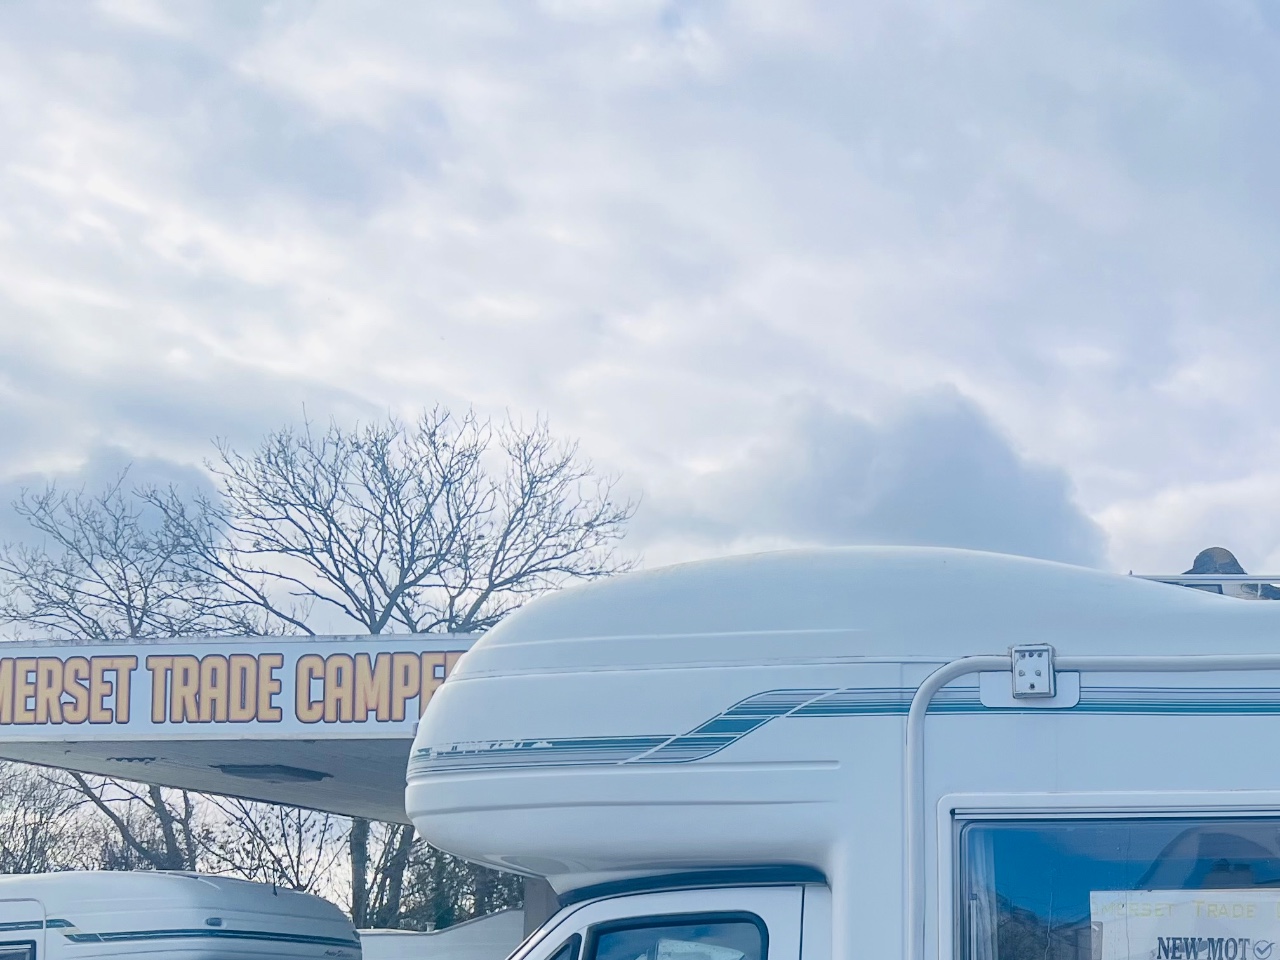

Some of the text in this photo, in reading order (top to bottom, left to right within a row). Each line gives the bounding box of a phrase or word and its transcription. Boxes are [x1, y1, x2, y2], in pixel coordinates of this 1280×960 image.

[146, 653, 284, 723] TRADE
[295, 651, 469, 724] CAMPE
[1157, 937, 1250, 960] NEW MOT
